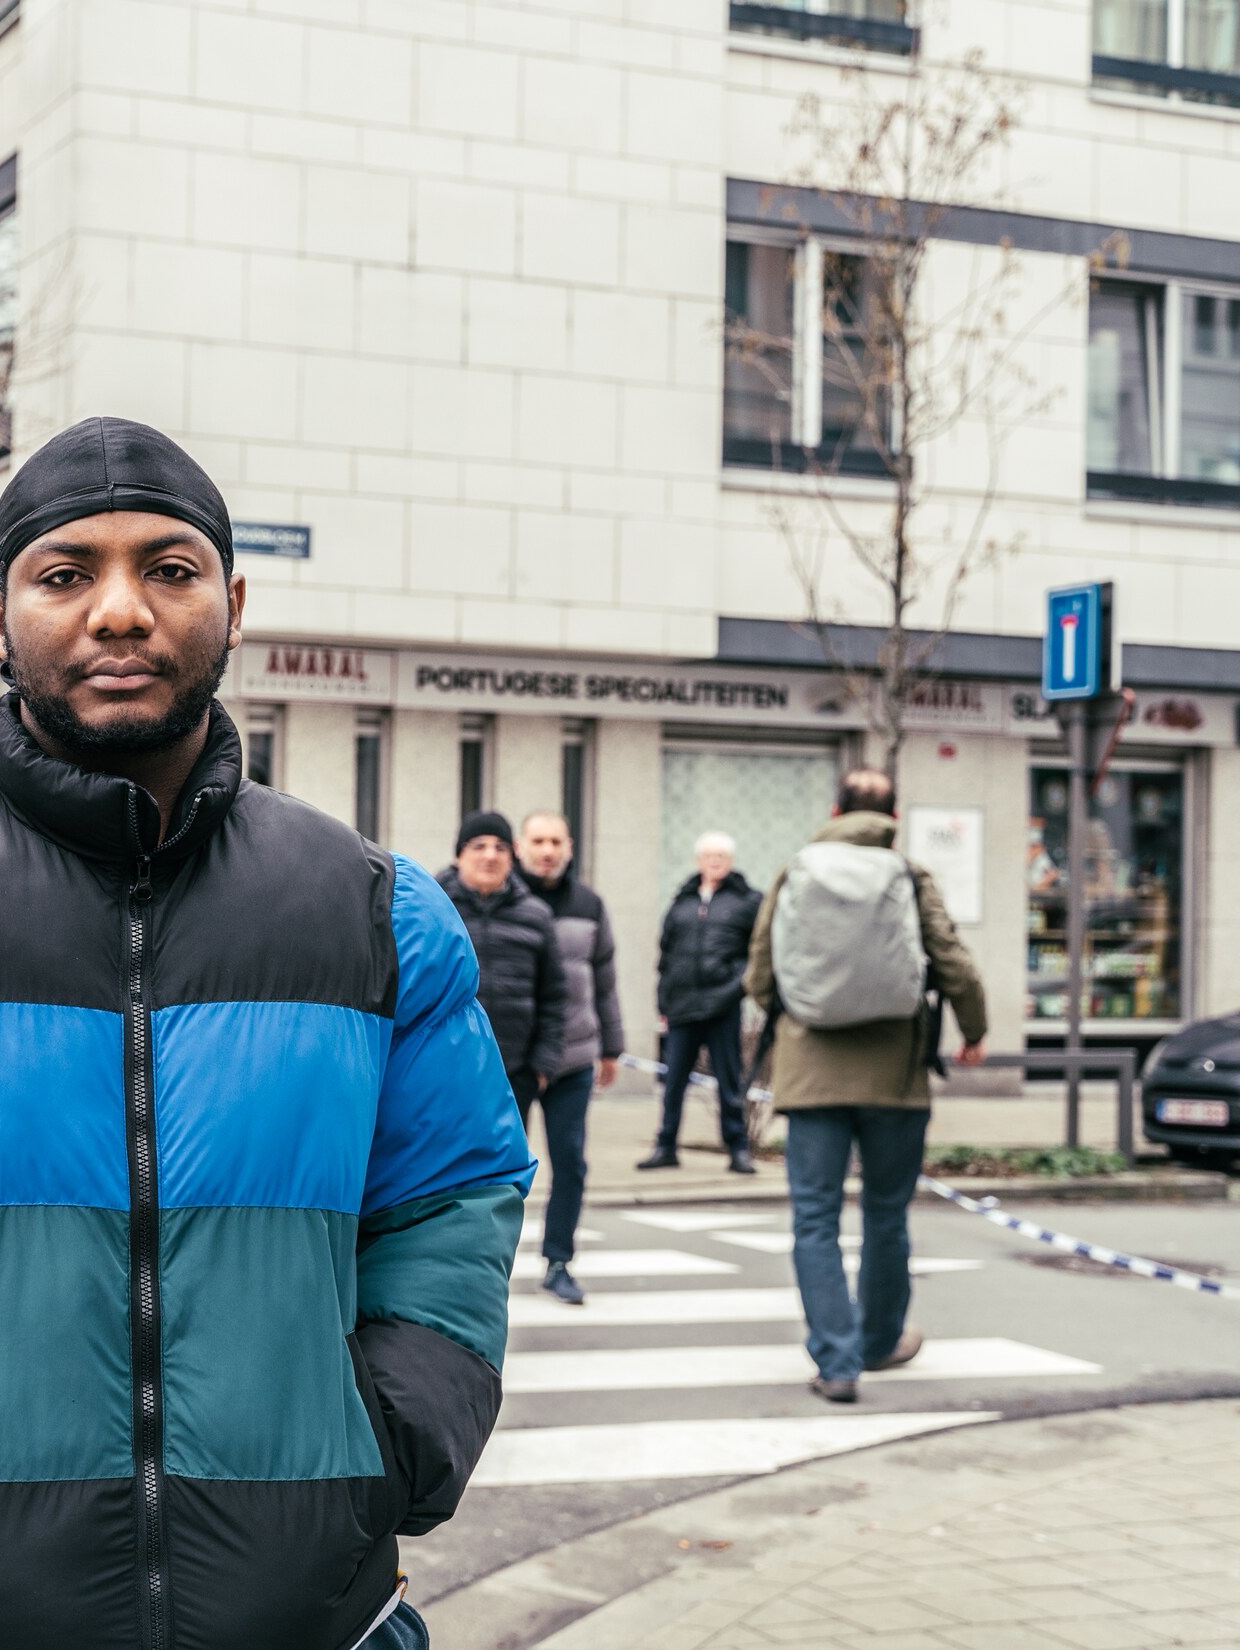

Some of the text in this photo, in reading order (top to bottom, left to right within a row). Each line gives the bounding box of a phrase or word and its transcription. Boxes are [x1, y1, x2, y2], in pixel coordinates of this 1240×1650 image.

[266, 646, 367, 681] AMARAL
[416, 664, 789, 709] PORTUGESE SPECIALITEITEN
